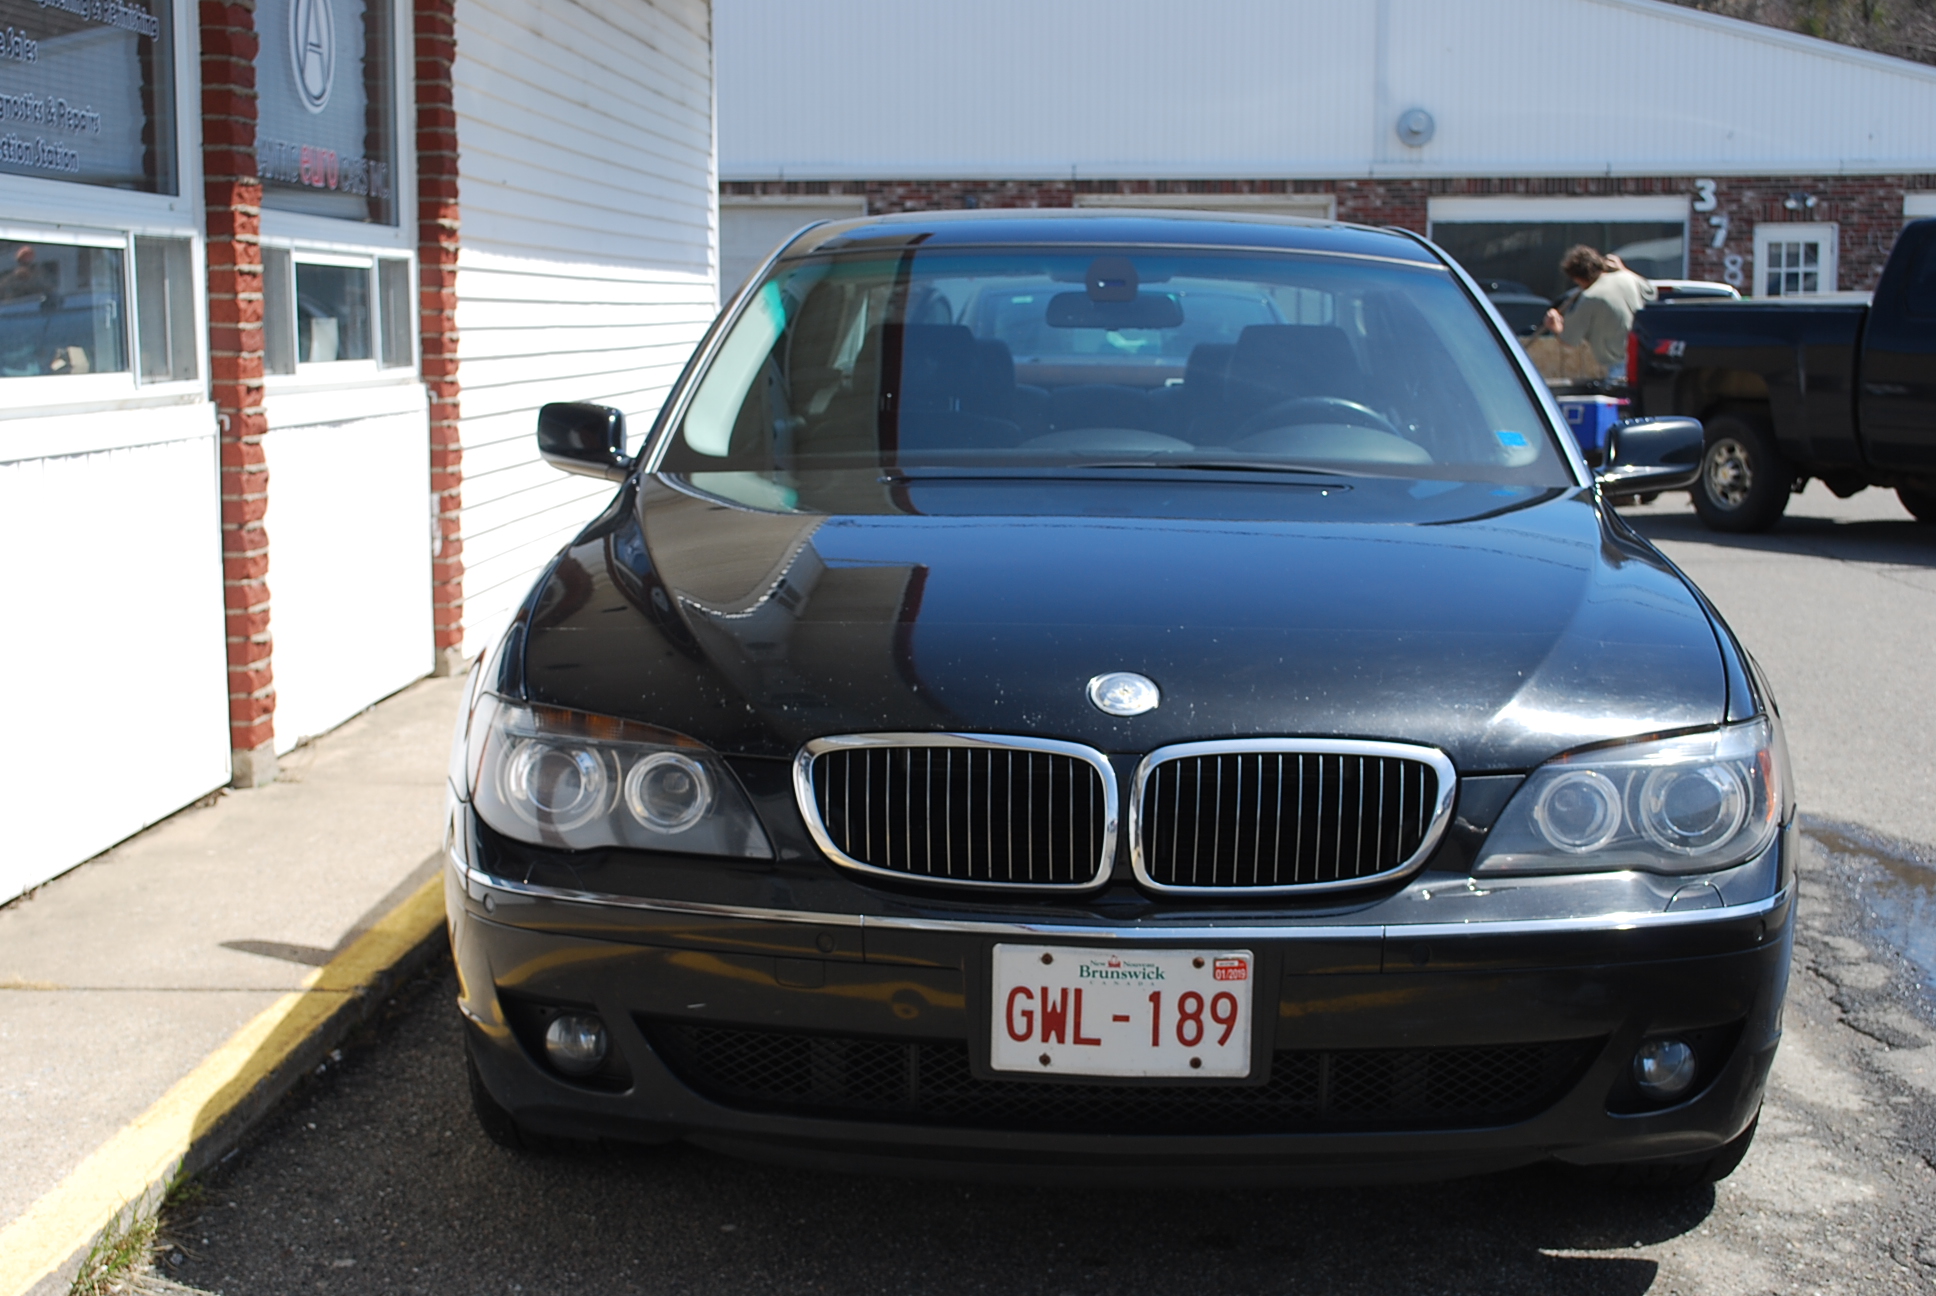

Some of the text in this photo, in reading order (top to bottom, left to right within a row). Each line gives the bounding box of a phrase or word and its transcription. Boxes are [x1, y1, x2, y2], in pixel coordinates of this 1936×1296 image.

[6, 26, 38, 64] Sales
[35, 136, 79, 173] Station
[1079, 964, 1166, 980] Brunswick
[1215, 968, 1246, 980] 01/2019
